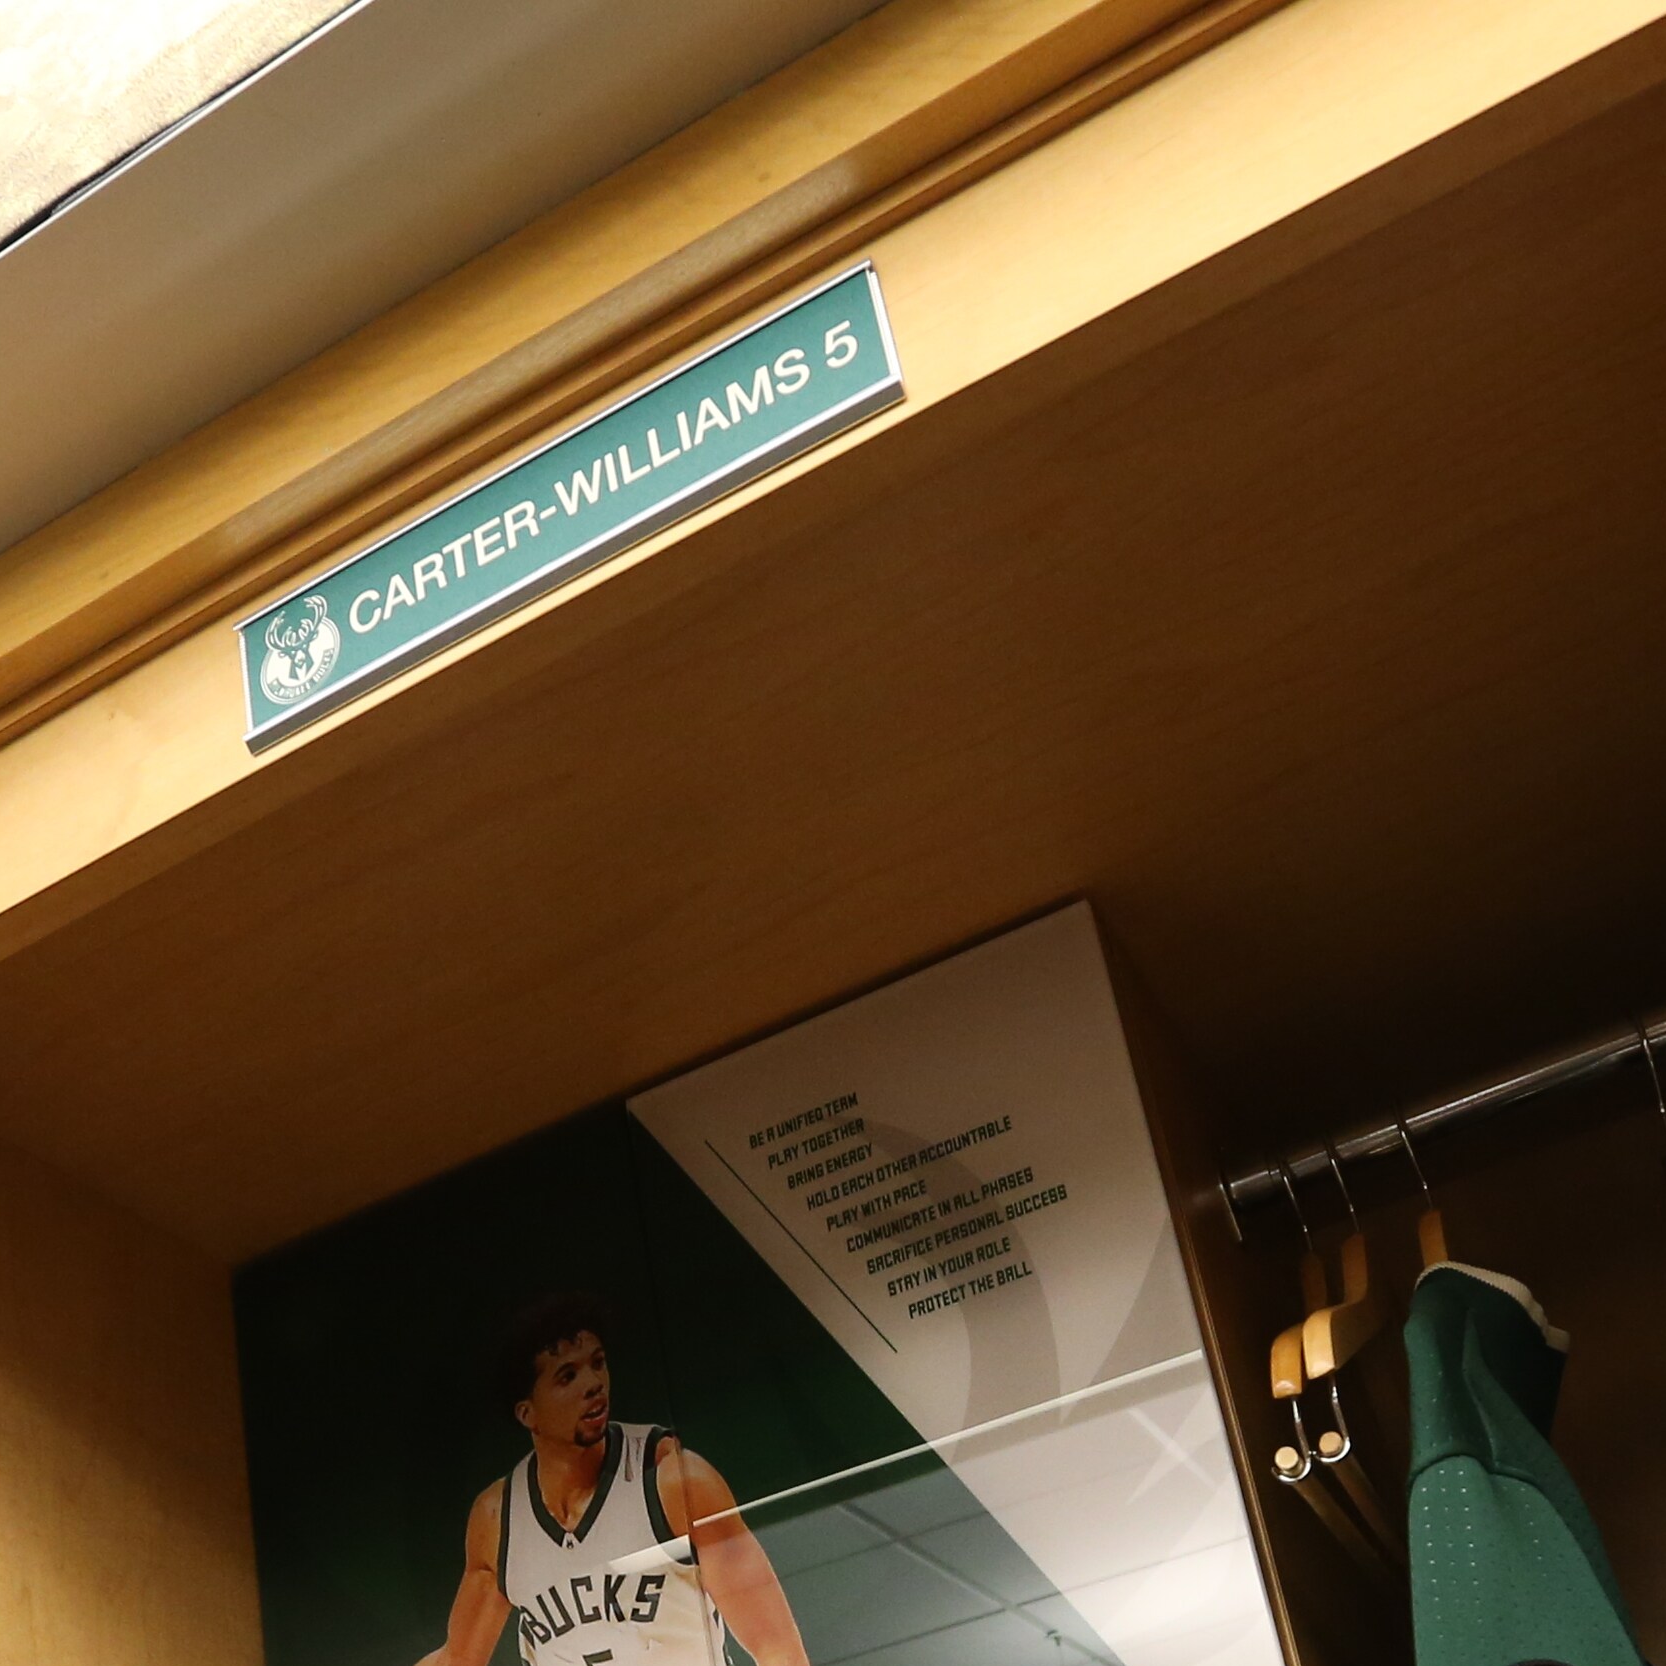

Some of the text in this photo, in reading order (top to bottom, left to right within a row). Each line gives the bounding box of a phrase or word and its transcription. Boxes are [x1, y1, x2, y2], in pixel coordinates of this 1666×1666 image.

[348, 320, 859, 634] CARTER-WILLIAMS 5
[749, 1092, 858, 1149] BE A UNIFIED TEAM
[768, 1117, 865, 1170] PLAY TOGETHER
[787, 1142, 873, 1190] BRING ENERGY
[806, 1115, 1012, 1211] HOLD EACH OTHER ACCOUNTABLE
[826, 1180, 927, 1232] PLAY WITH PACE
[846, 1166, 1033, 1253] COMMUNICATE IN ALL PHASES
[867, 1184, 1067, 1275] SACRIFICE PERSONAL SUCCESS
[887, 1237, 1011, 1297] STAY IN YOUR ROLE
[908, 1261, 1032, 1320] PROTECT THE BALL
[519, 1574, 667, 1650] BUCKS
